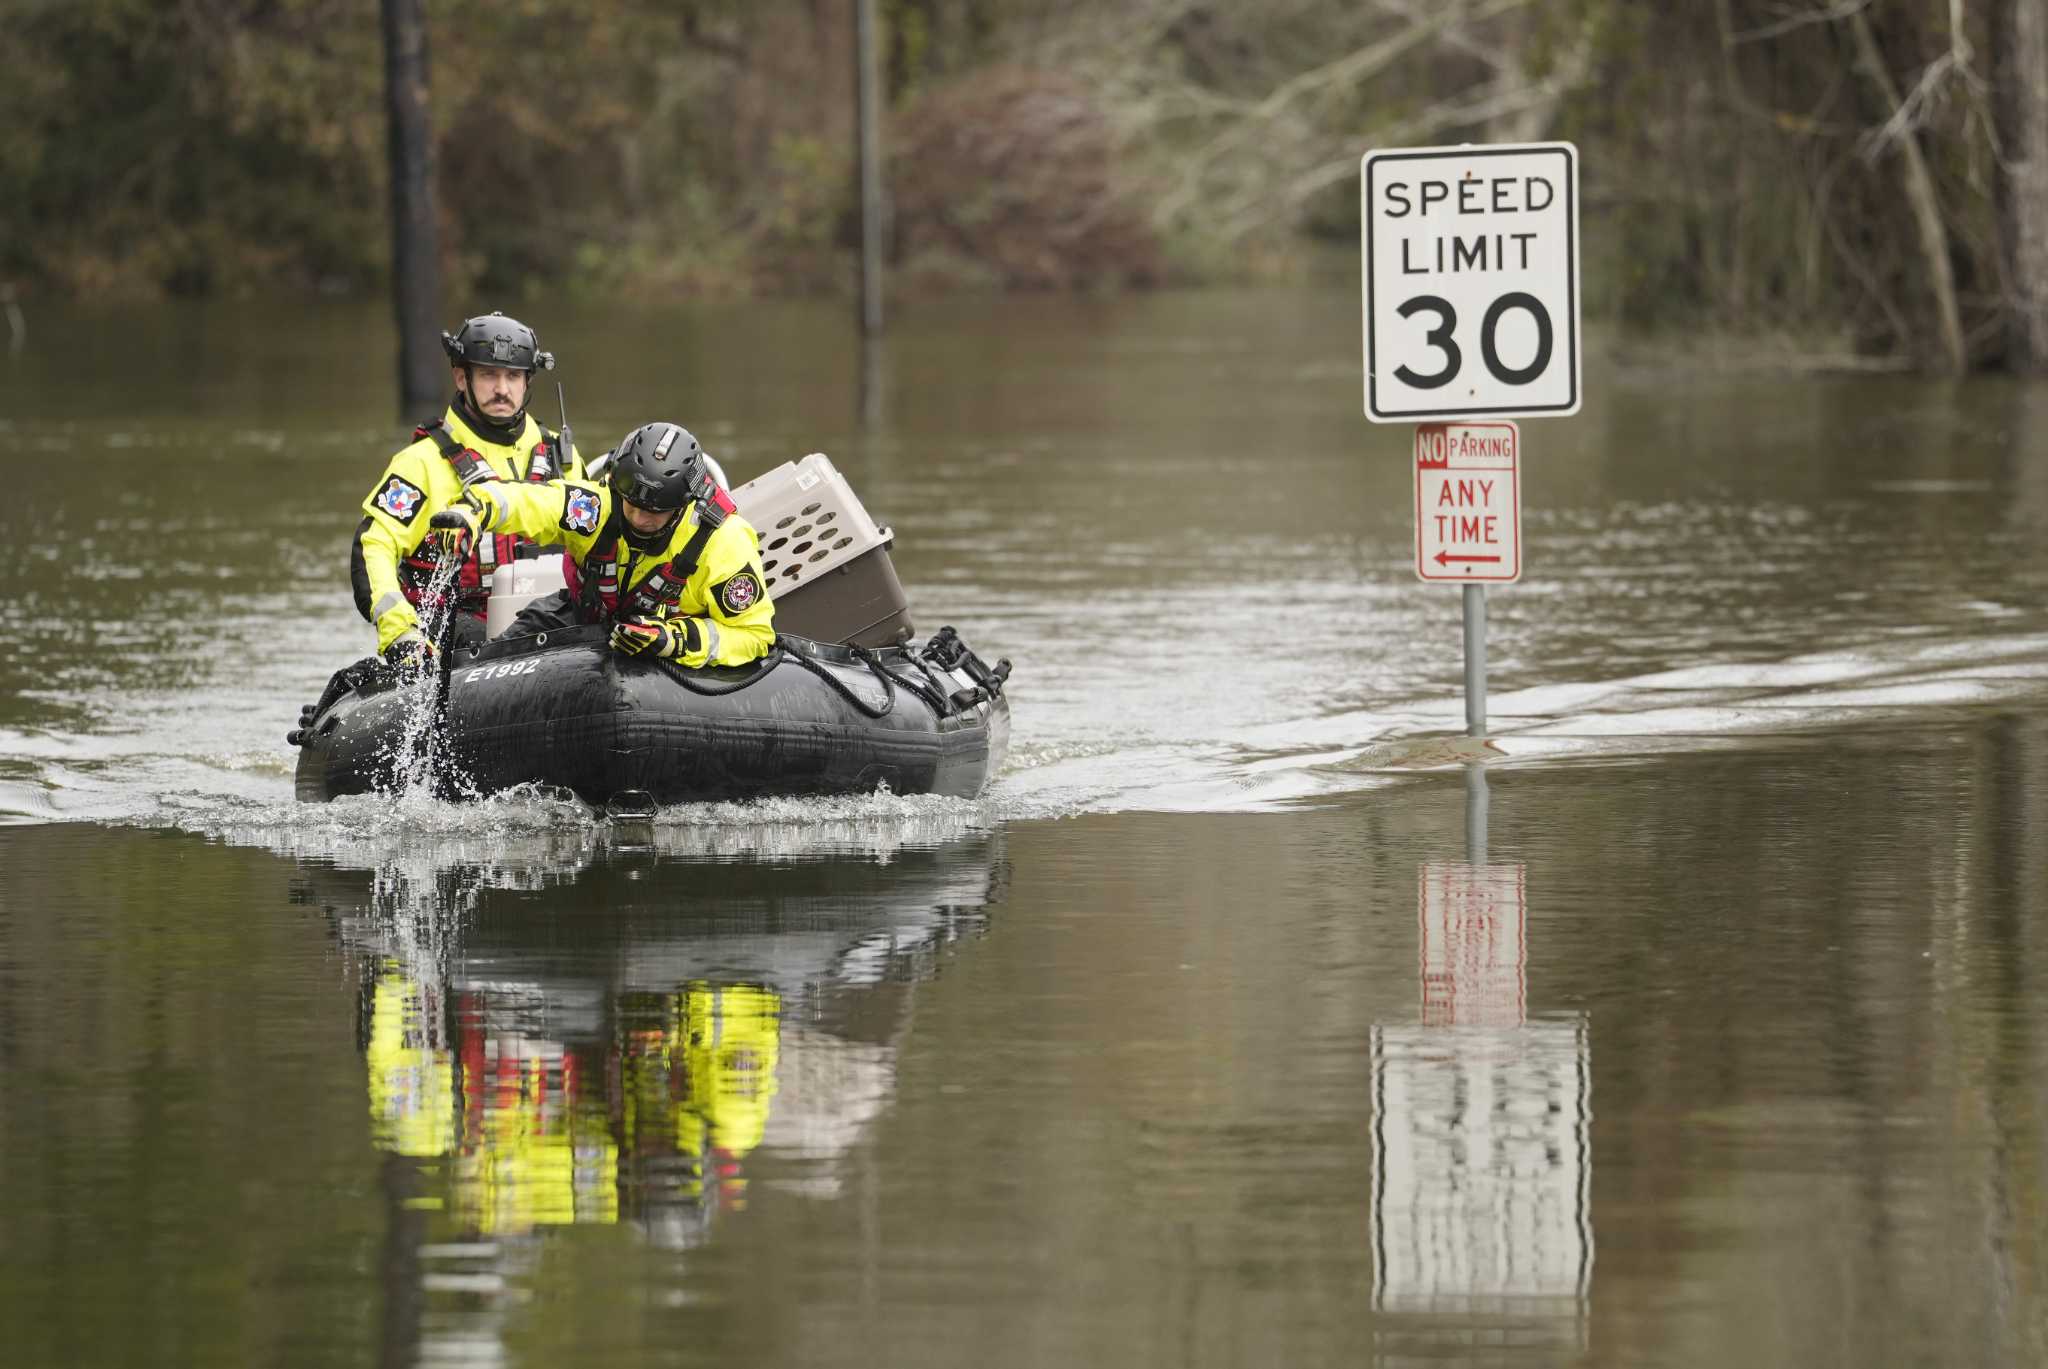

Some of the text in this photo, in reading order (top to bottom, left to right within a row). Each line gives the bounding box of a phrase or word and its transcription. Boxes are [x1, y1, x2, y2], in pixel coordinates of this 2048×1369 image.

[1384, 177, 1554, 218] SPEED
[1402, 233, 1537, 274] LIMIT
[1393, 291, 1553, 390] 30
[1418, 432, 1511, 463] NO PARKING
[1438, 479, 1494, 507] ANY
[1434, 516, 1498, 544] TIME
[465, 658, 541, 683] E1992
